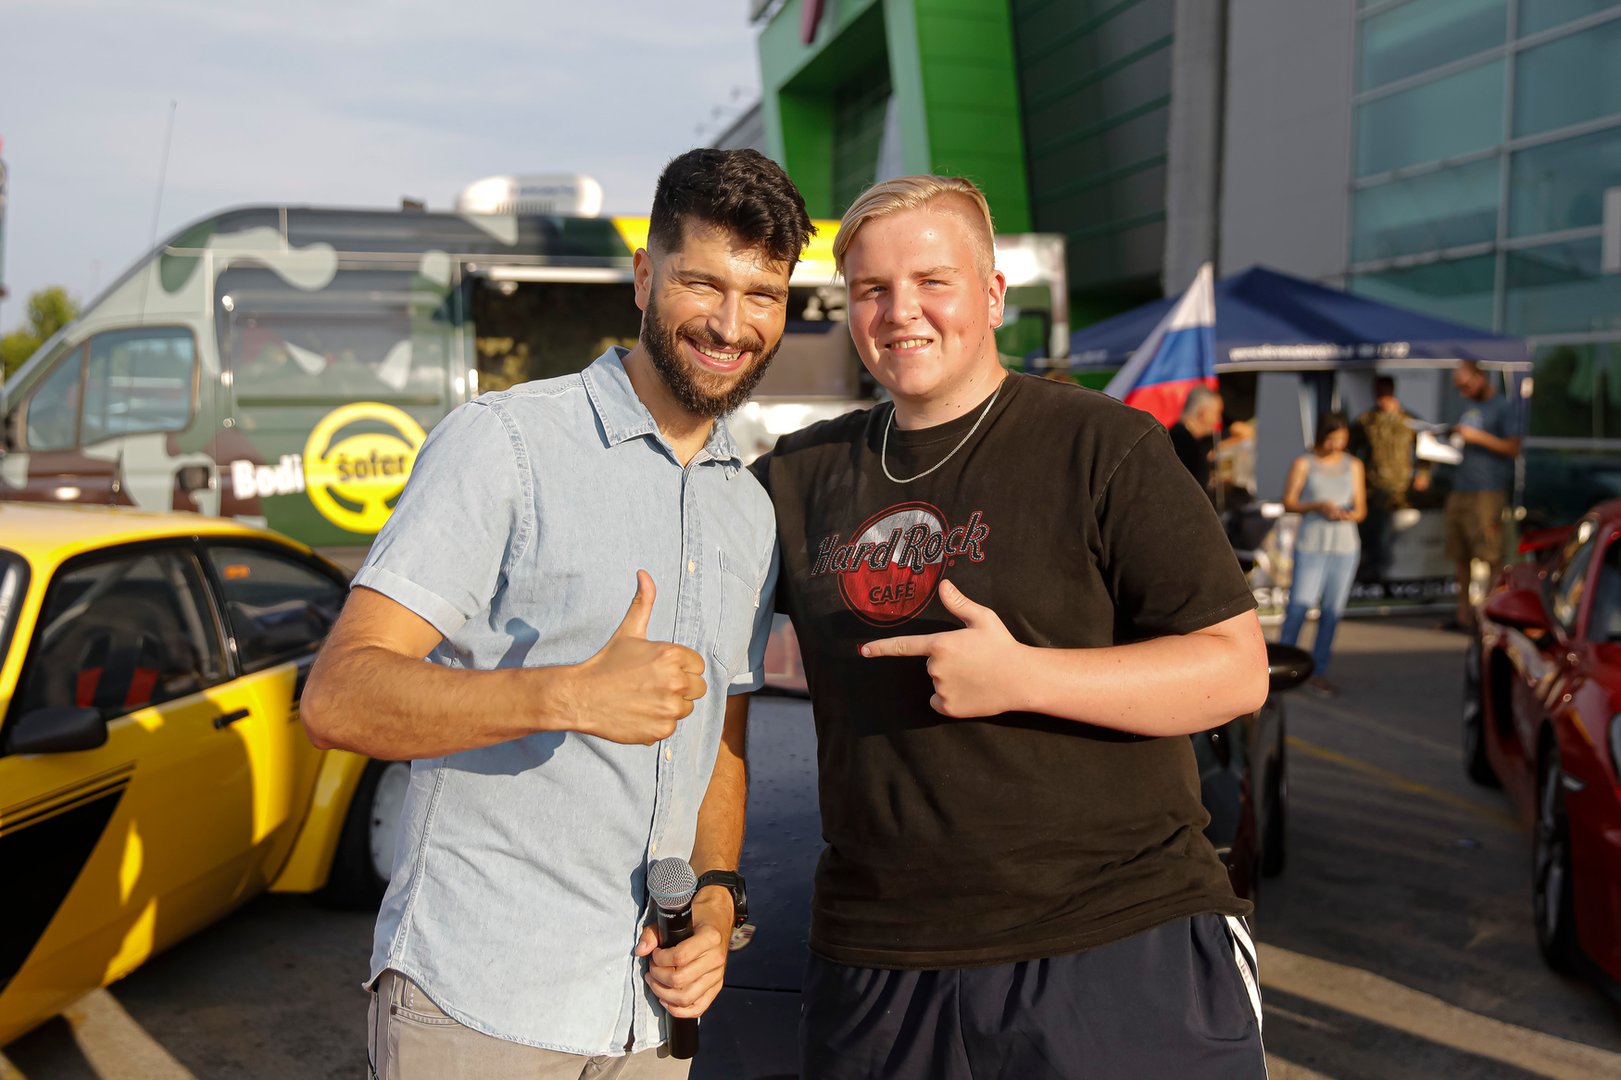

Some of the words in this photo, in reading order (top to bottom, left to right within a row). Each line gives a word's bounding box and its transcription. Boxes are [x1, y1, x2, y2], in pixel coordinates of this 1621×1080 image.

[231, 454, 305, 500] Bodi
[811, 529, 903, 576] Hard
[896, 510, 990, 574] Rock
[868, 581, 917, 605] CAFE
